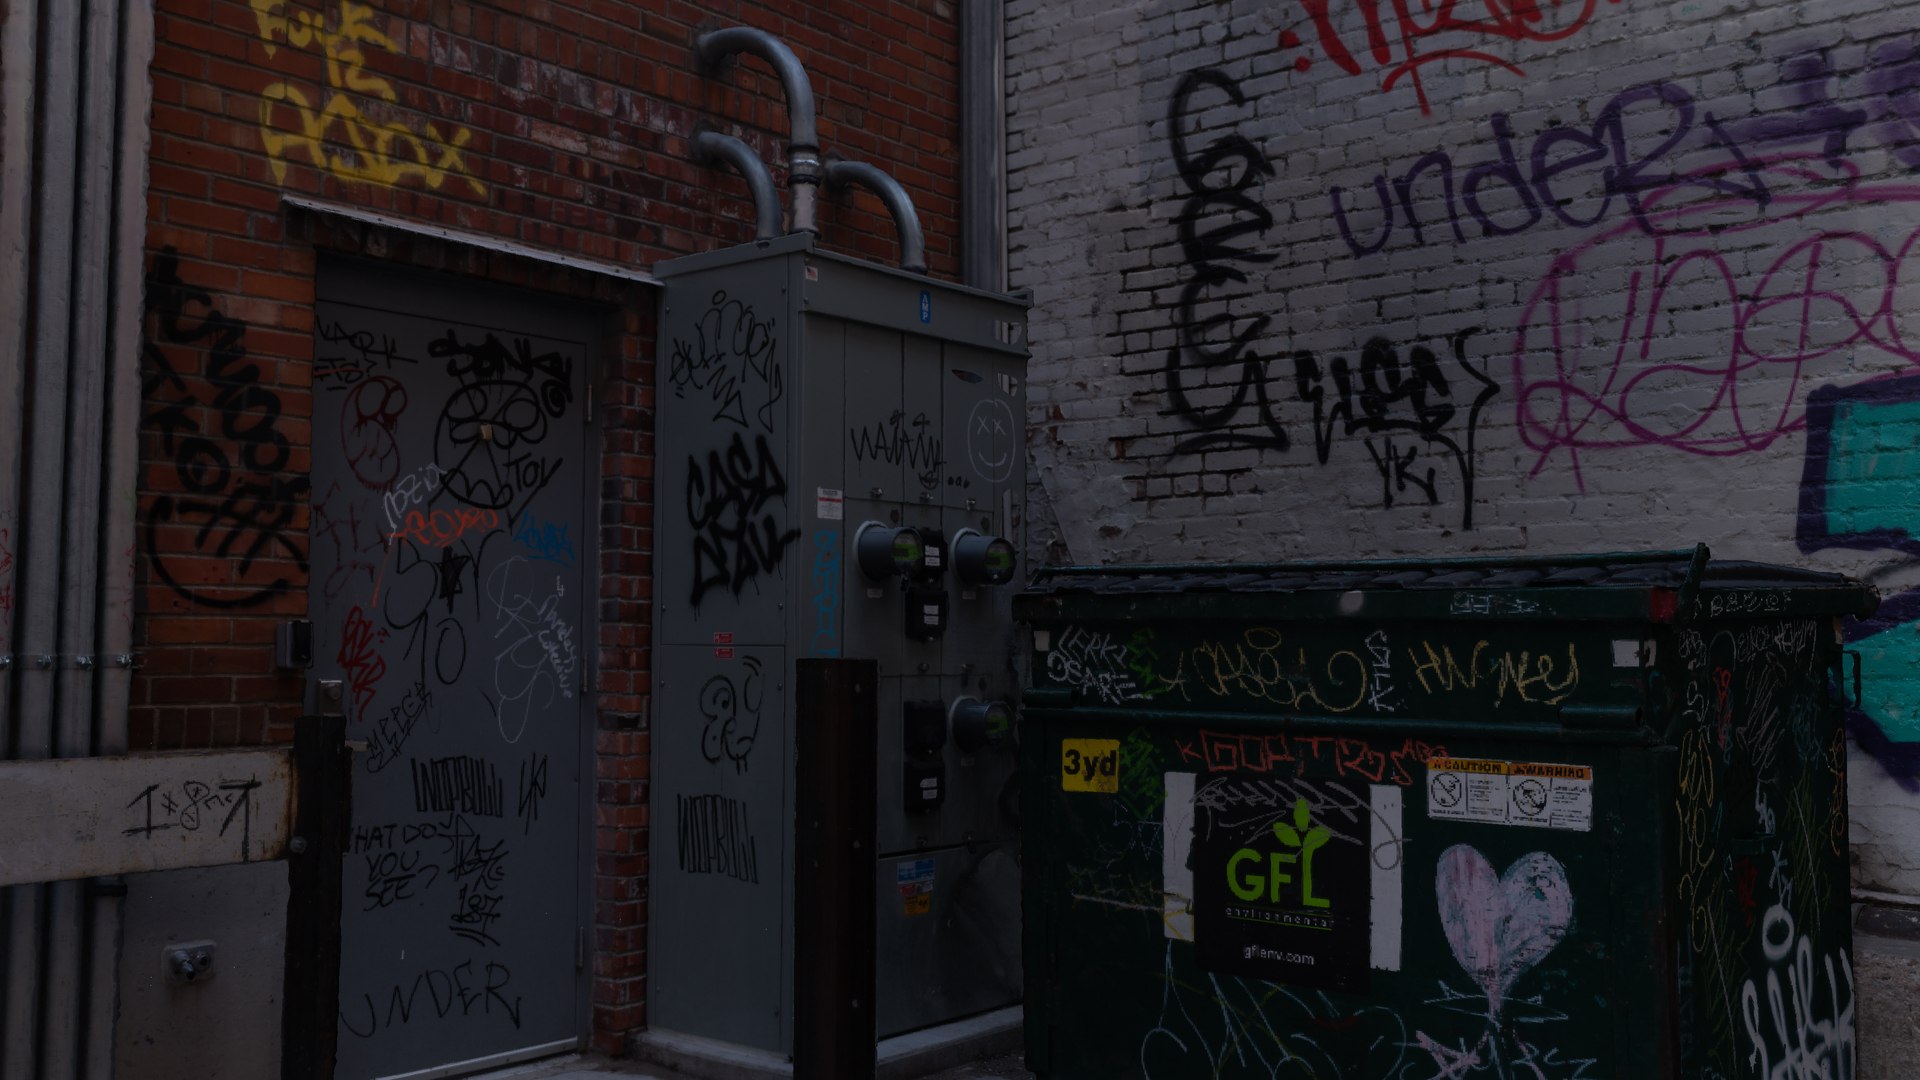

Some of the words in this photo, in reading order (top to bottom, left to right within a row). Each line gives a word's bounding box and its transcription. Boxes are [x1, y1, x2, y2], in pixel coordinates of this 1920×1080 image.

[1063, 748, 1117, 781] 3yd
[350, 823, 398, 855] HAT
[1225, 846, 1333, 909] GFL
[1243, 944, 1316, 967] gflenv.com
